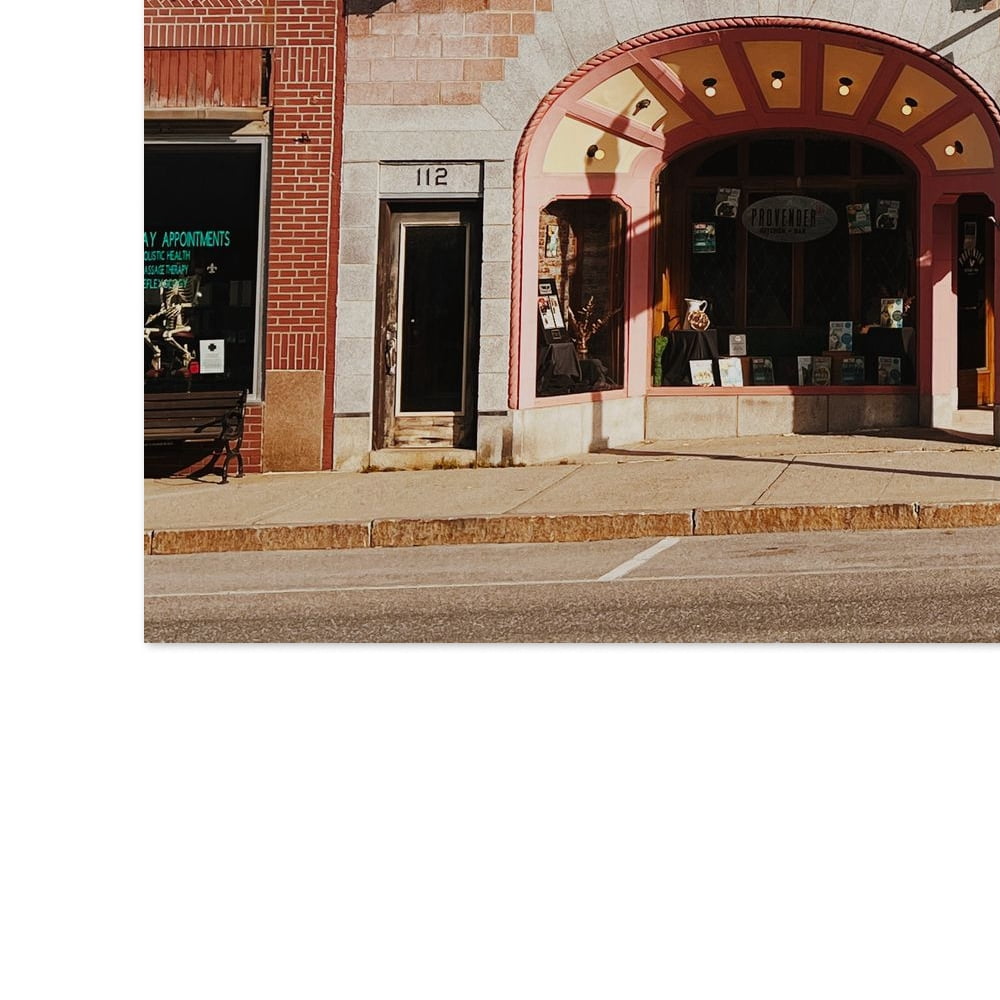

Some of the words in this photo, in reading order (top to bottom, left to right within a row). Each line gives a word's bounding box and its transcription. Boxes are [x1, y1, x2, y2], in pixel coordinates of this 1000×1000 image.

[416, 167, 448, 186] 112
[751, 208, 816, 227] PROVENDER
[162, 230, 231, 248] APPOINTMENTS
[167, 250, 191, 261] HEALTH
